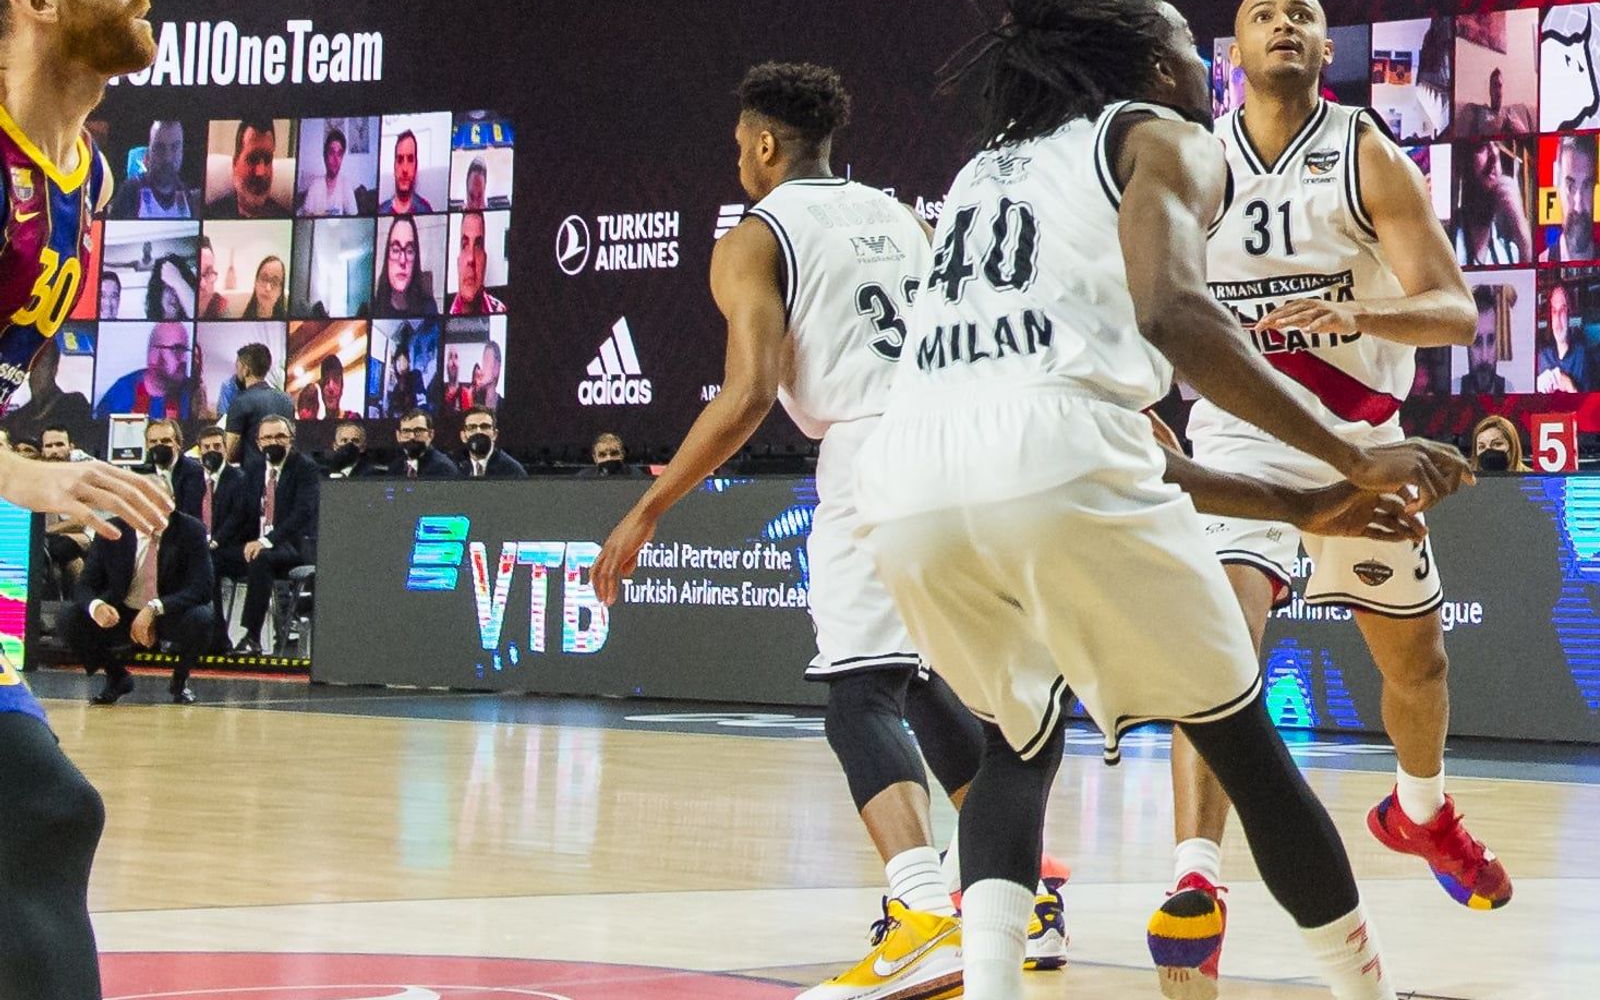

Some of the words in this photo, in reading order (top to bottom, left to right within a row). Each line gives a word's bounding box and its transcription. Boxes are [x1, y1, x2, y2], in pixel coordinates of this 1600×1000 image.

[108, 19, 383, 86] AllOneTeam
[597, 211, 679, 240] TURKISH
[915, 196, 945, 220] Ass
[1243, 198, 1296, 259] 31
[595, 241, 679, 272] AIRLINES
[928, 196, 1041, 305] 40
[11, 247, 82, 338] 30
[917, 309, 1053, 371] MILAN
[578, 374, 652, 406] adidas
[1538, 422, 1567, 472] 5
[637, 542, 678, 568] ficial
[682, 543, 741, 569] Partner
[743, 543, 762, 569] of
[764, 543, 792, 570] the
[469, 541, 610, 654] VTB
[622, 577, 677, 604] Turkish
[680, 579, 738, 606] Airlines
[742, 581, 807, 608] EuroLea
[1441, 601, 1483, 631] gue
